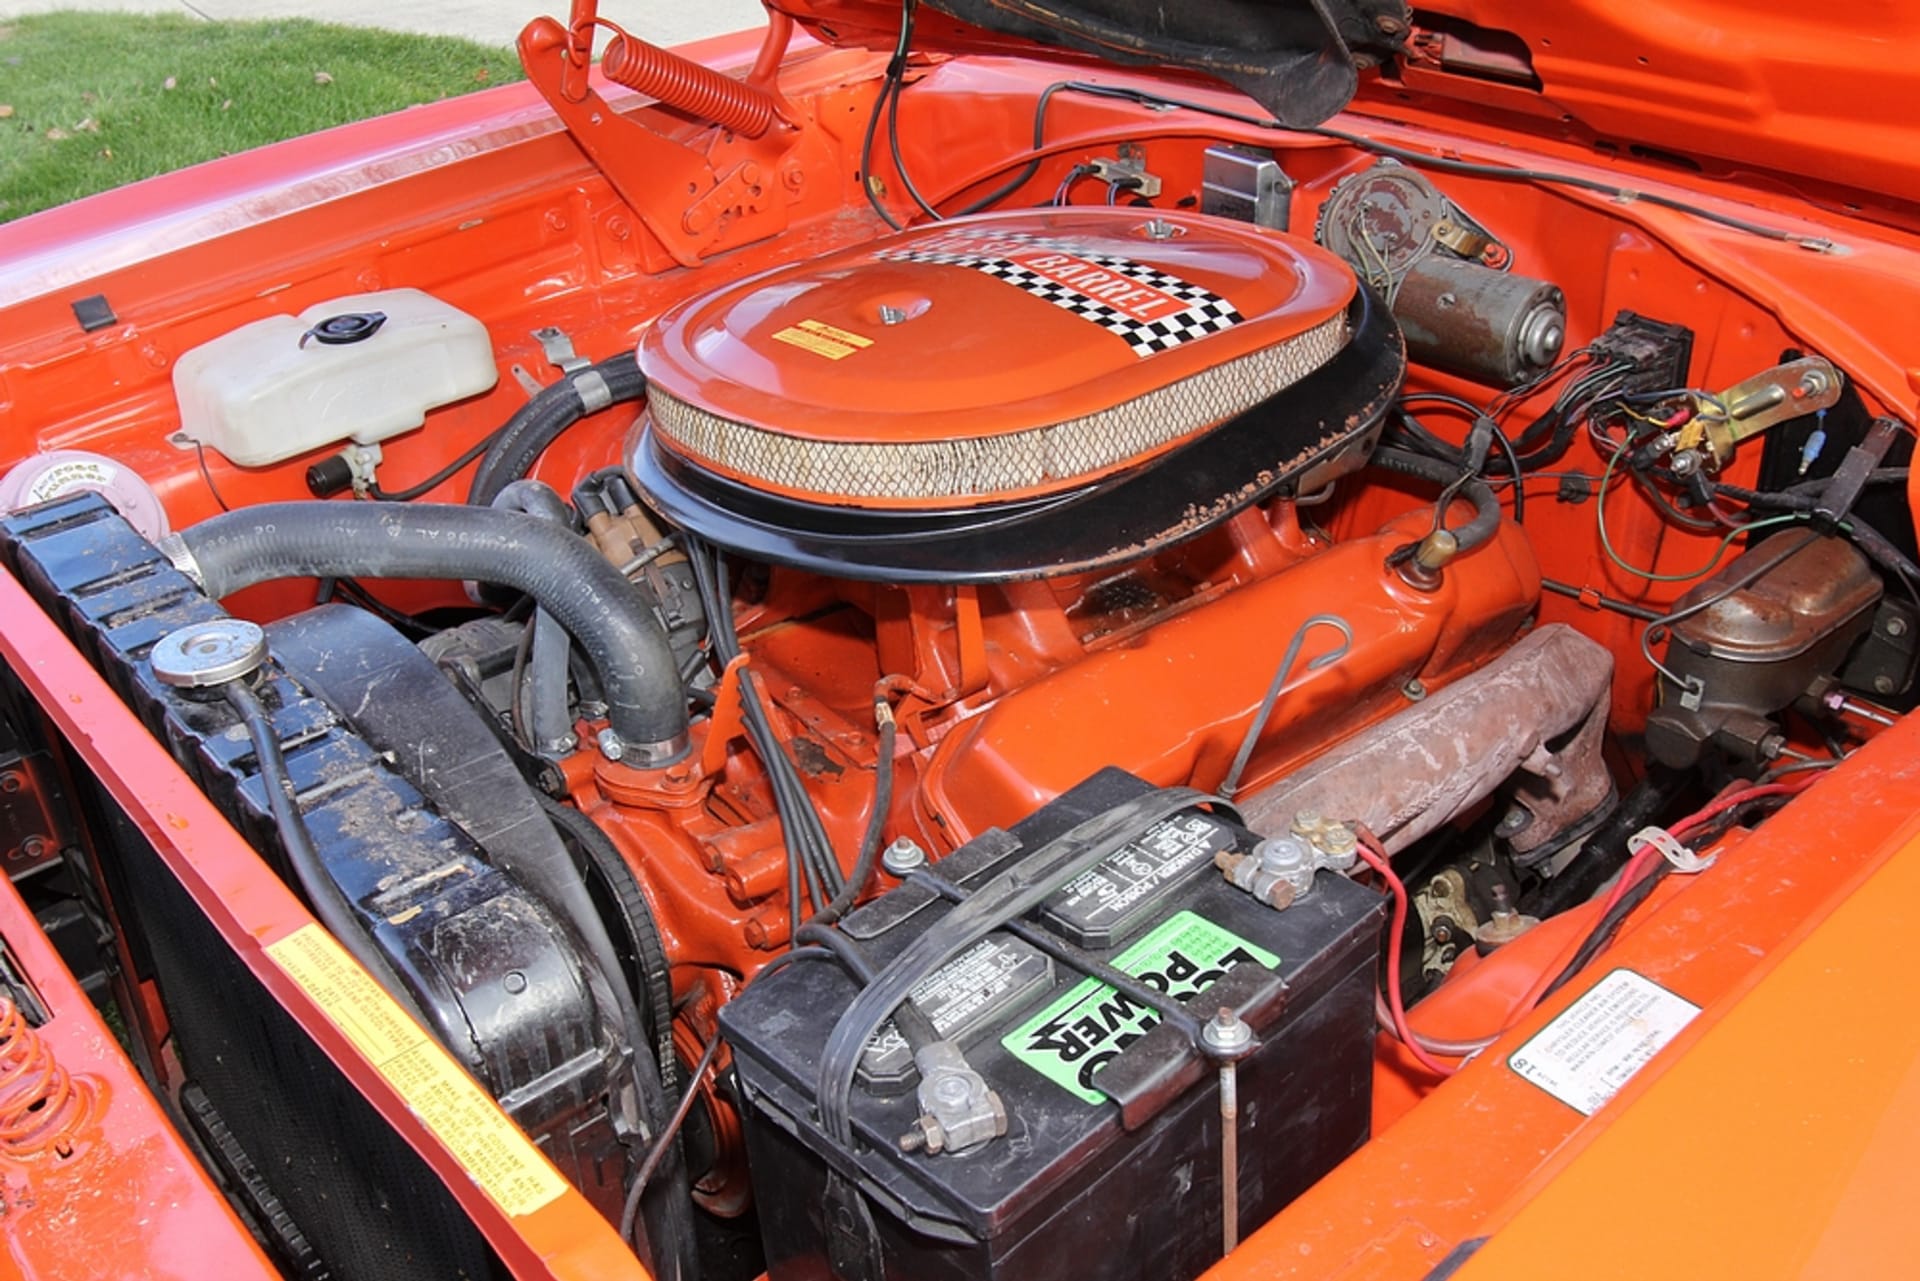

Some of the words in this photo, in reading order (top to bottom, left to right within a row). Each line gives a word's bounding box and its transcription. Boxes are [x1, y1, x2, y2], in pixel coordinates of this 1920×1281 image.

[1025, 254, 1169, 318] BARREL
[1028, 950, 1199, 1063] POWER
[409, 1048, 441, 1078] ALWAYS
[437, 1079, 463, 1102] MAKE
[461, 1104, 487, 1127] SURE
[484, 1130, 527, 1171] COOLANT
[524, 1174, 548, 1195] HAS
[427, 1083, 461, 1115] AMOUNT
[457, 1116, 473, 1129] OF
[469, 1130, 515, 1174] CHRYSLER
[471, 1147, 508, 1183] MANUAL
[505, 1186, 528, 1206] FOR
